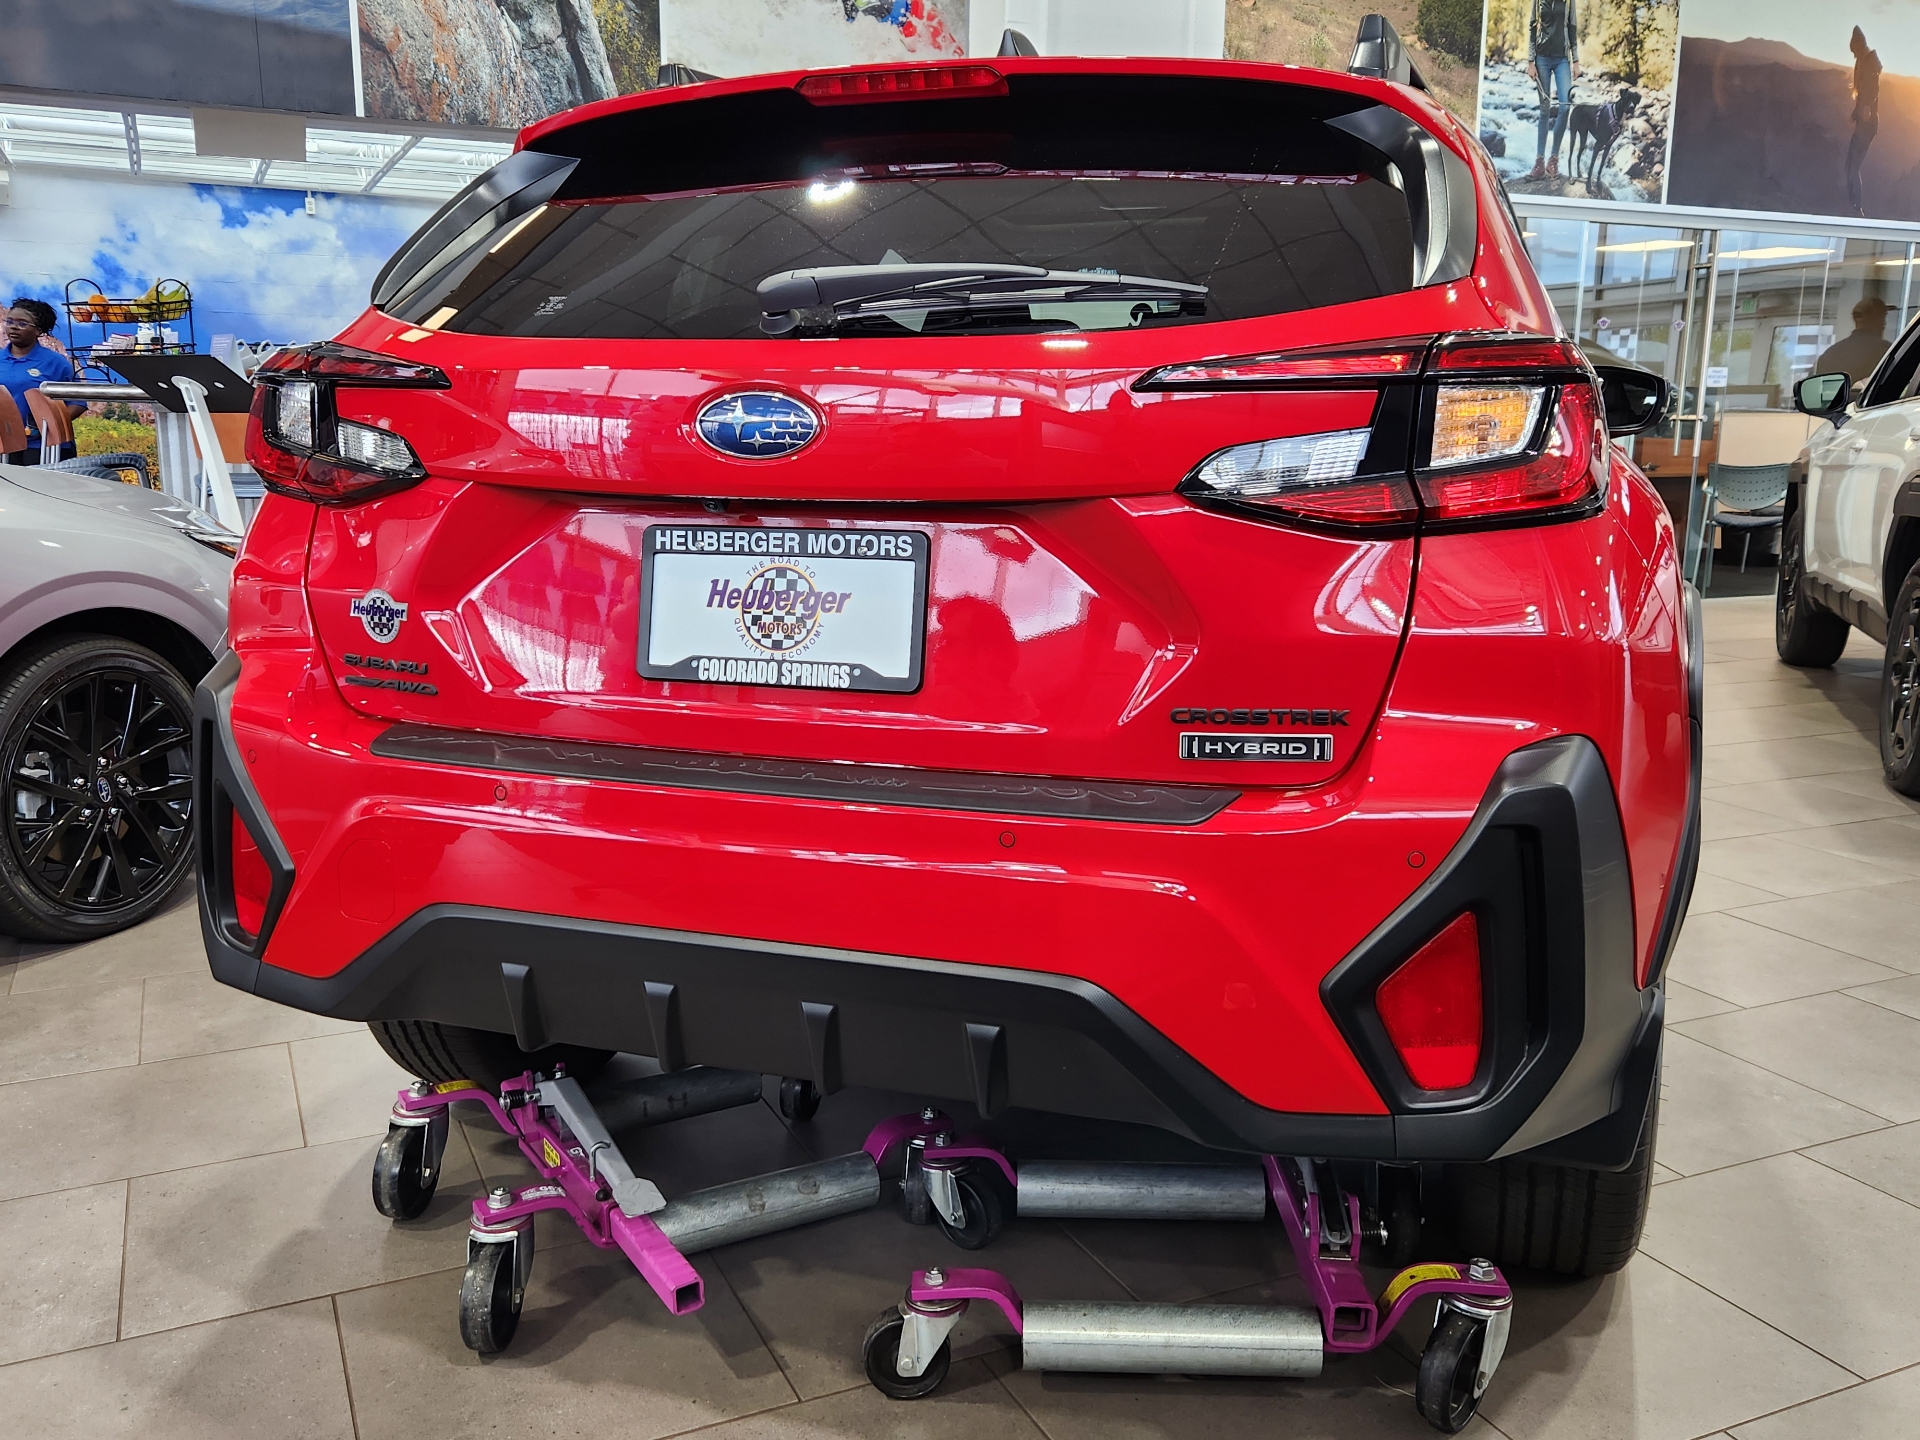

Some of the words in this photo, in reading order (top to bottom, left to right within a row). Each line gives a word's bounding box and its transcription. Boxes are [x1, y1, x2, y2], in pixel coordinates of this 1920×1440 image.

[655, 530, 800, 553] HEUBERGER
[808, 533, 913, 557] MOTORS
[746, 561, 766, 578] THE
[770, 556, 800, 567] ROAD
[804, 565, 816, 579] TO
[706, 578, 852, 621] Heuberger
[353, 600, 406, 621] Heuberger
[757, 621, 803, 635] MOTORS
[734, 617, 766, 657] QUALITY
[781, 622, 825, 661] ECONOMY
[344, 654, 428, 674] SUBARU
[698, 658, 778, 683] COLORADO
[781, 662, 851, 689] SPRINGS
[380, 680, 438, 695] AWD
[1170, 707, 1350, 727] CROSSTREK
[1205, 741, 1307, 755] HYBRID
